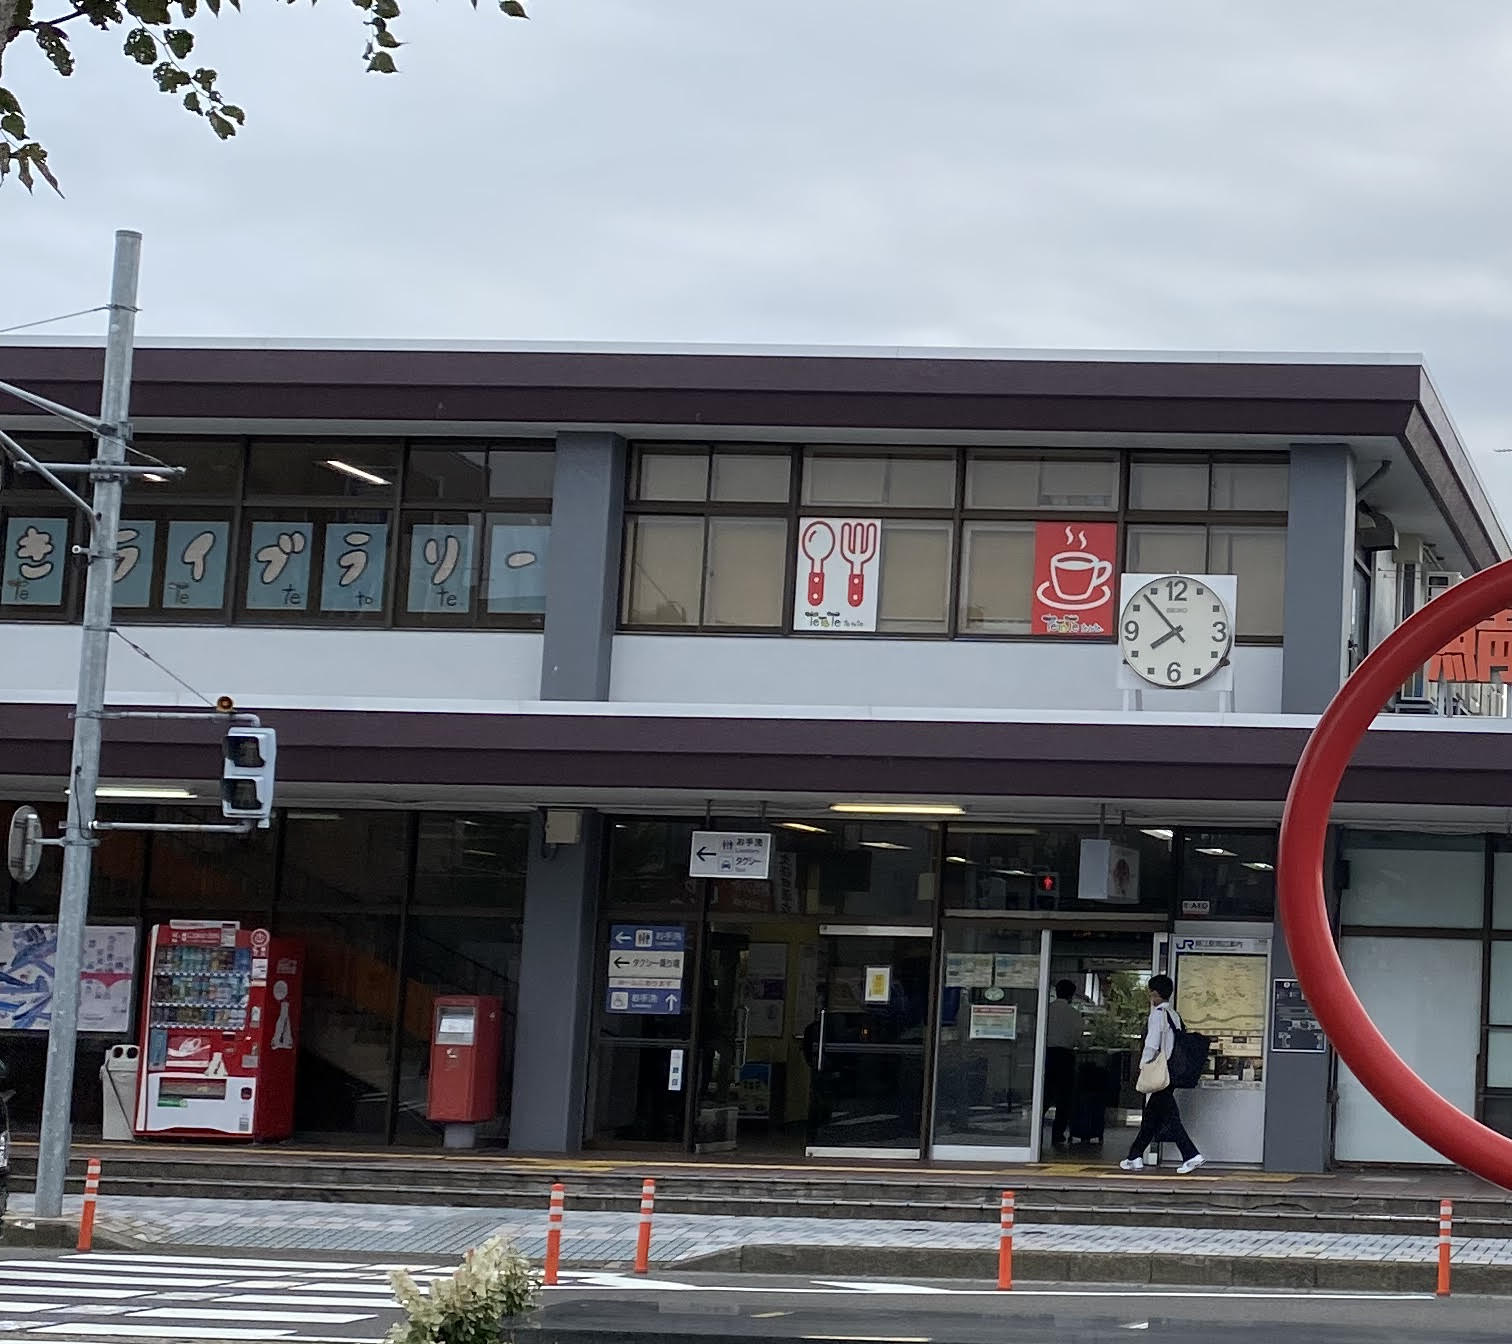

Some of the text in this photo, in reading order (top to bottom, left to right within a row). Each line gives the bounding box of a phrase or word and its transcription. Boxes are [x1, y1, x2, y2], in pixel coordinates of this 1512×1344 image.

[1166, 581, 1188, 601] 12
[1124, 620, 1139, 641] 9
[1211, 621, 1227, 642] 3
[1166, 662, 1181, 682] 6
[735, 857, 762, 866] タクシー
[1176, 940, 1195, 950] JR
